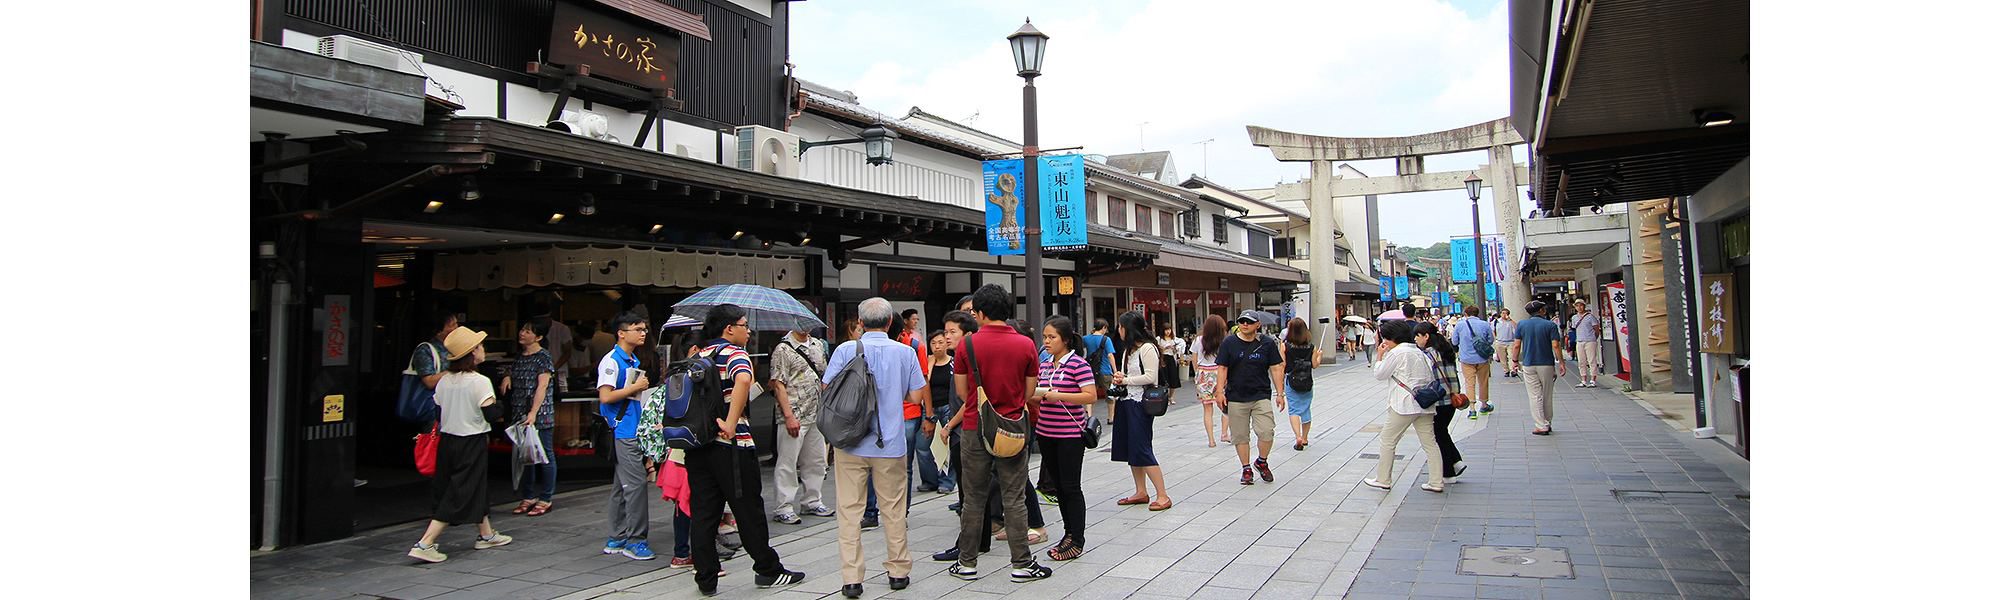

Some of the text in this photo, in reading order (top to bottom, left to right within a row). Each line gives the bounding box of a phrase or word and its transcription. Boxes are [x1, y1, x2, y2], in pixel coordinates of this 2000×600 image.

[574, 24, 663, 74] かさの家
[1054, 171, 1071, 236] 東山魁夷
